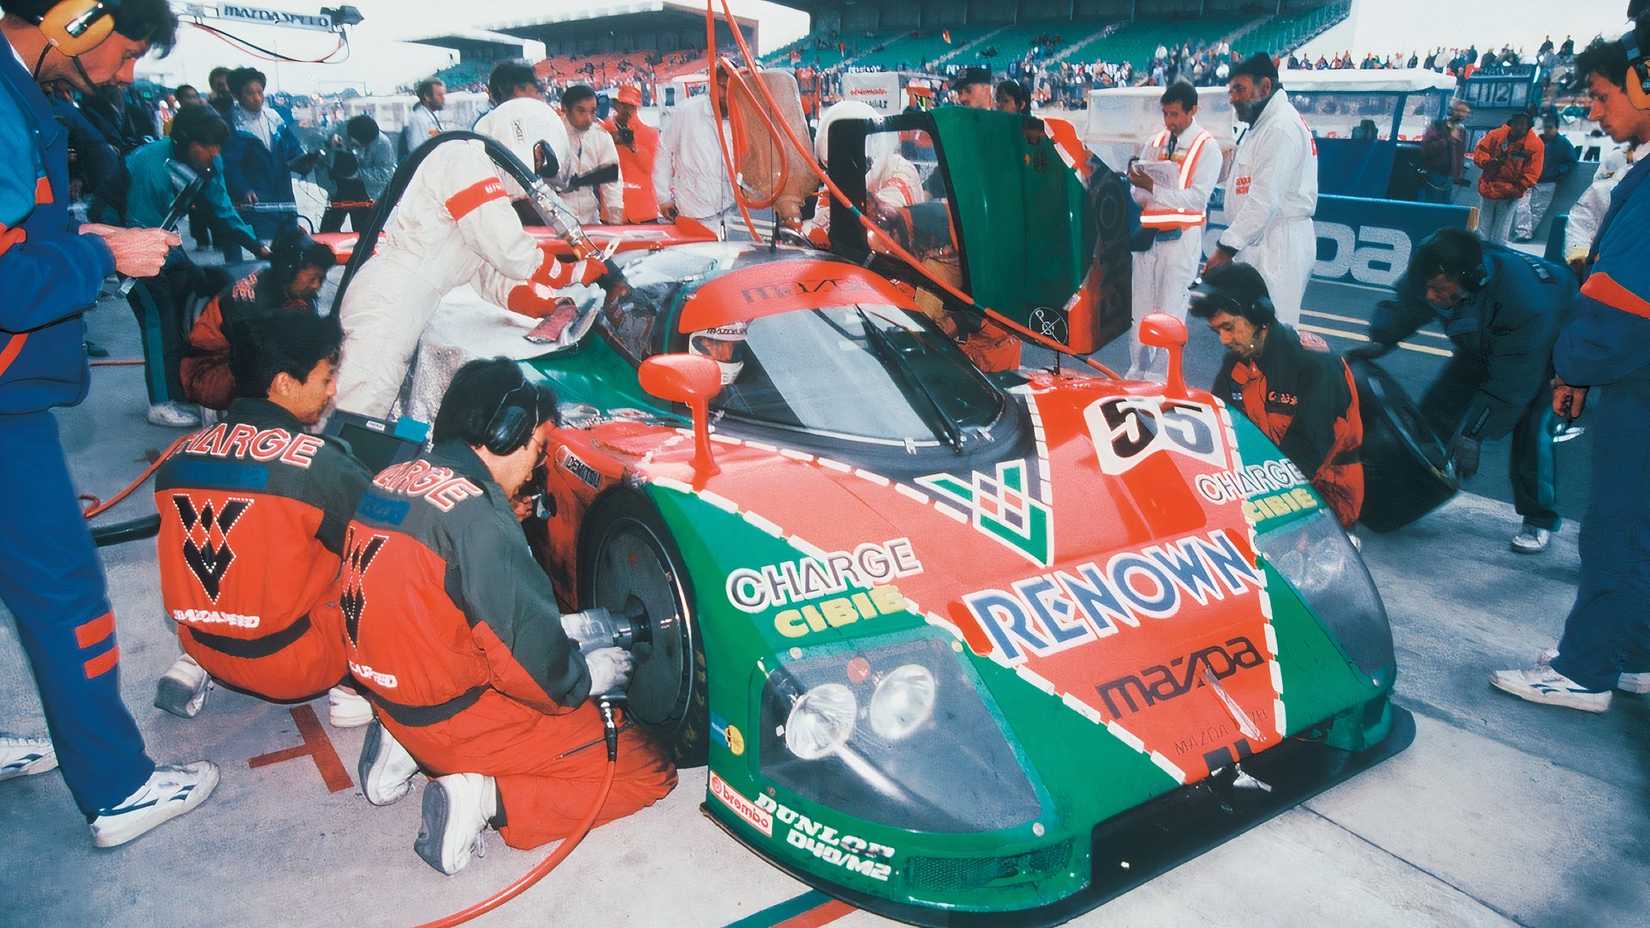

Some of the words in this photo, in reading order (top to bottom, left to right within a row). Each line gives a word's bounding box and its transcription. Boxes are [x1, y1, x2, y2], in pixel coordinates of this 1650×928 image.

[1100, 398, 1215, 459] 55
[1194, 458, 1311, 505] CHARGE
[726, 537, 924, 614] CHARGE
[962, 529, 1268, 667] RENOWN
[774, 584, 908, 638] CIBIE
[722, 785, 769, 829] brembo
[754, 792, 896, 858] DUNLOP
